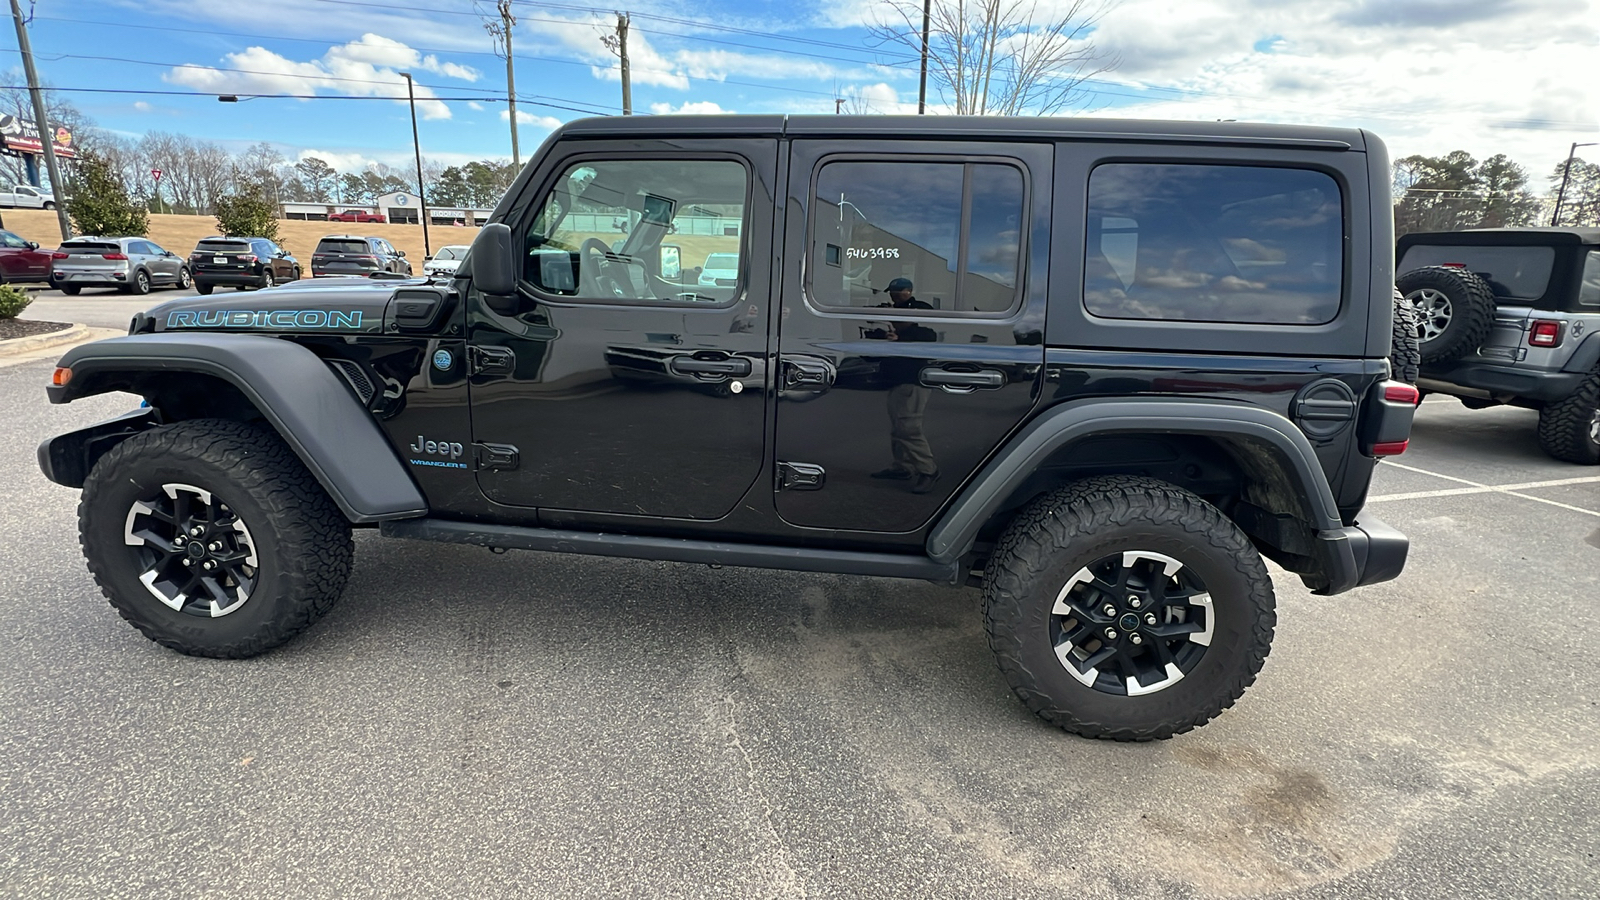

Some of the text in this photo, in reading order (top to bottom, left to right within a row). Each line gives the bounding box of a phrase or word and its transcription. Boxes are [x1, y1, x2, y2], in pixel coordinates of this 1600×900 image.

[846, 247, 900, 259] 5463958
[167, 310, 363, 329] RUBICON
[410, 435, 463, 460] Jeep
[410, 459, 459, 468] WRANGLER
